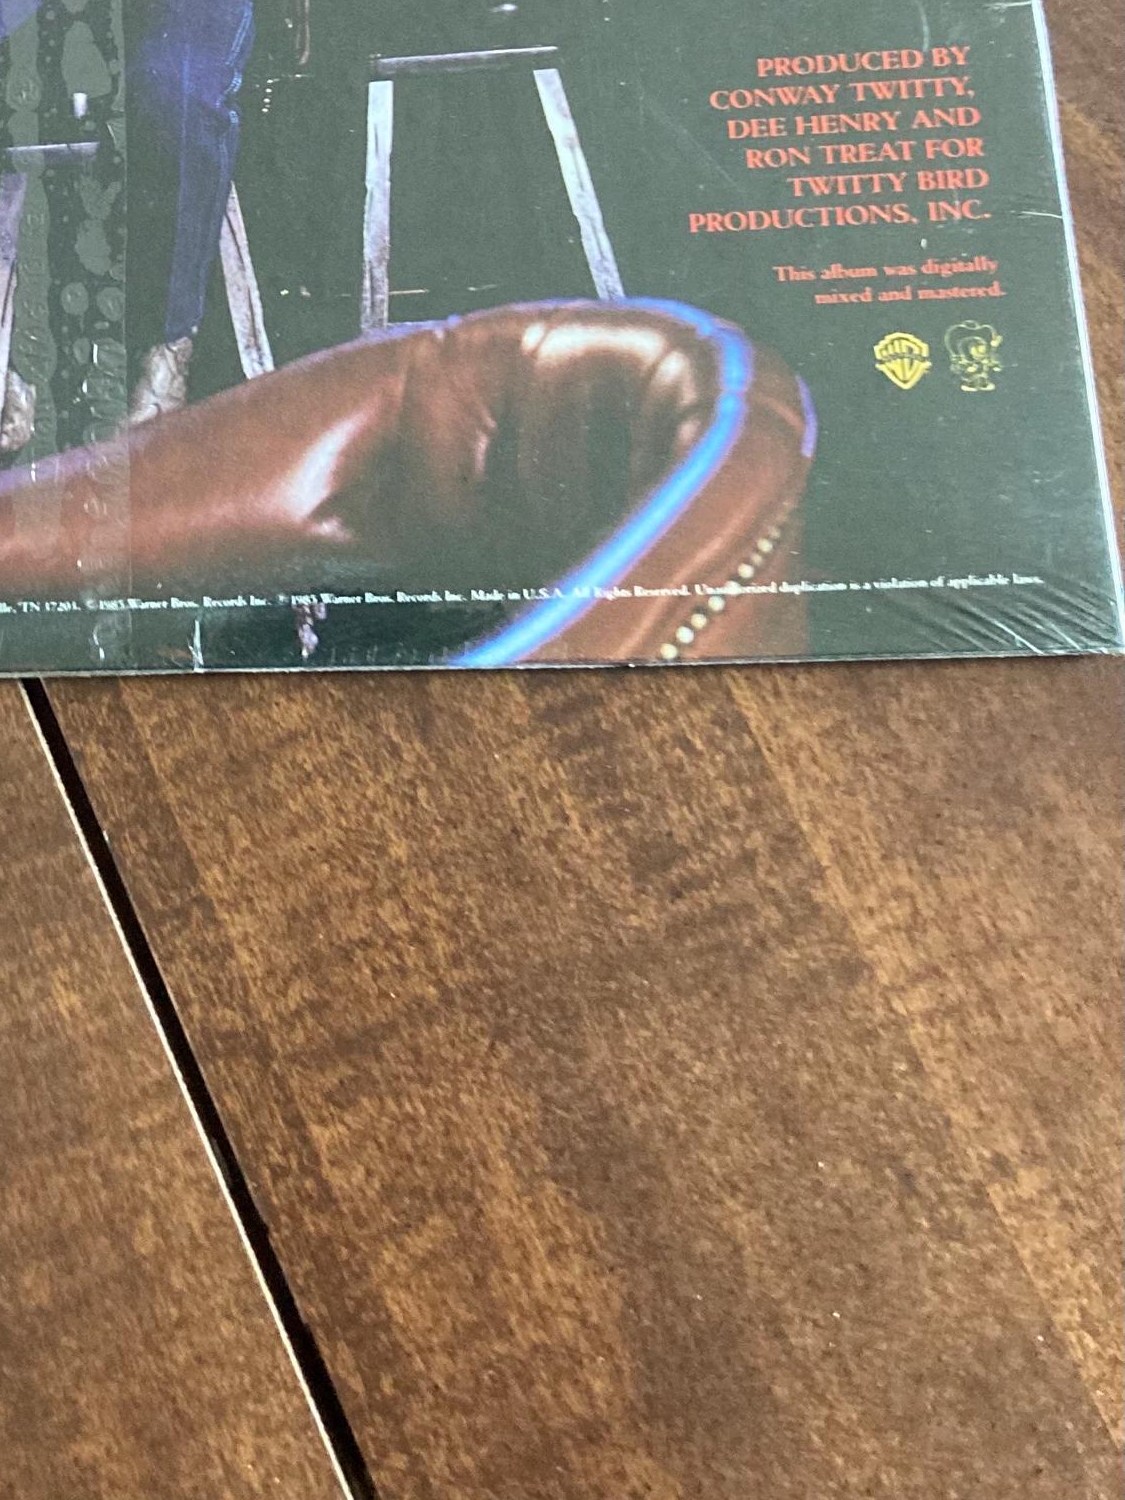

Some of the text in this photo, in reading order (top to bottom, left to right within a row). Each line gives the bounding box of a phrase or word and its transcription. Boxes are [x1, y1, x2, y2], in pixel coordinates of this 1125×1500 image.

[756, 46, 971, 78] PRODUCED BY
[709, 76, 975, 110] CONWAY TWITTY,
[727, 106, 982, 140] DEE HENRY AND
[745, 137, 985, 169] RON TREAT FOR
[786, 168, 989, 197] TWITTY BIRD
[927, 199, 993, 222] INC.
[773, 255, 999, 282] This album was digitally
[814, 280, 1007, 306] mixed and mastered.
